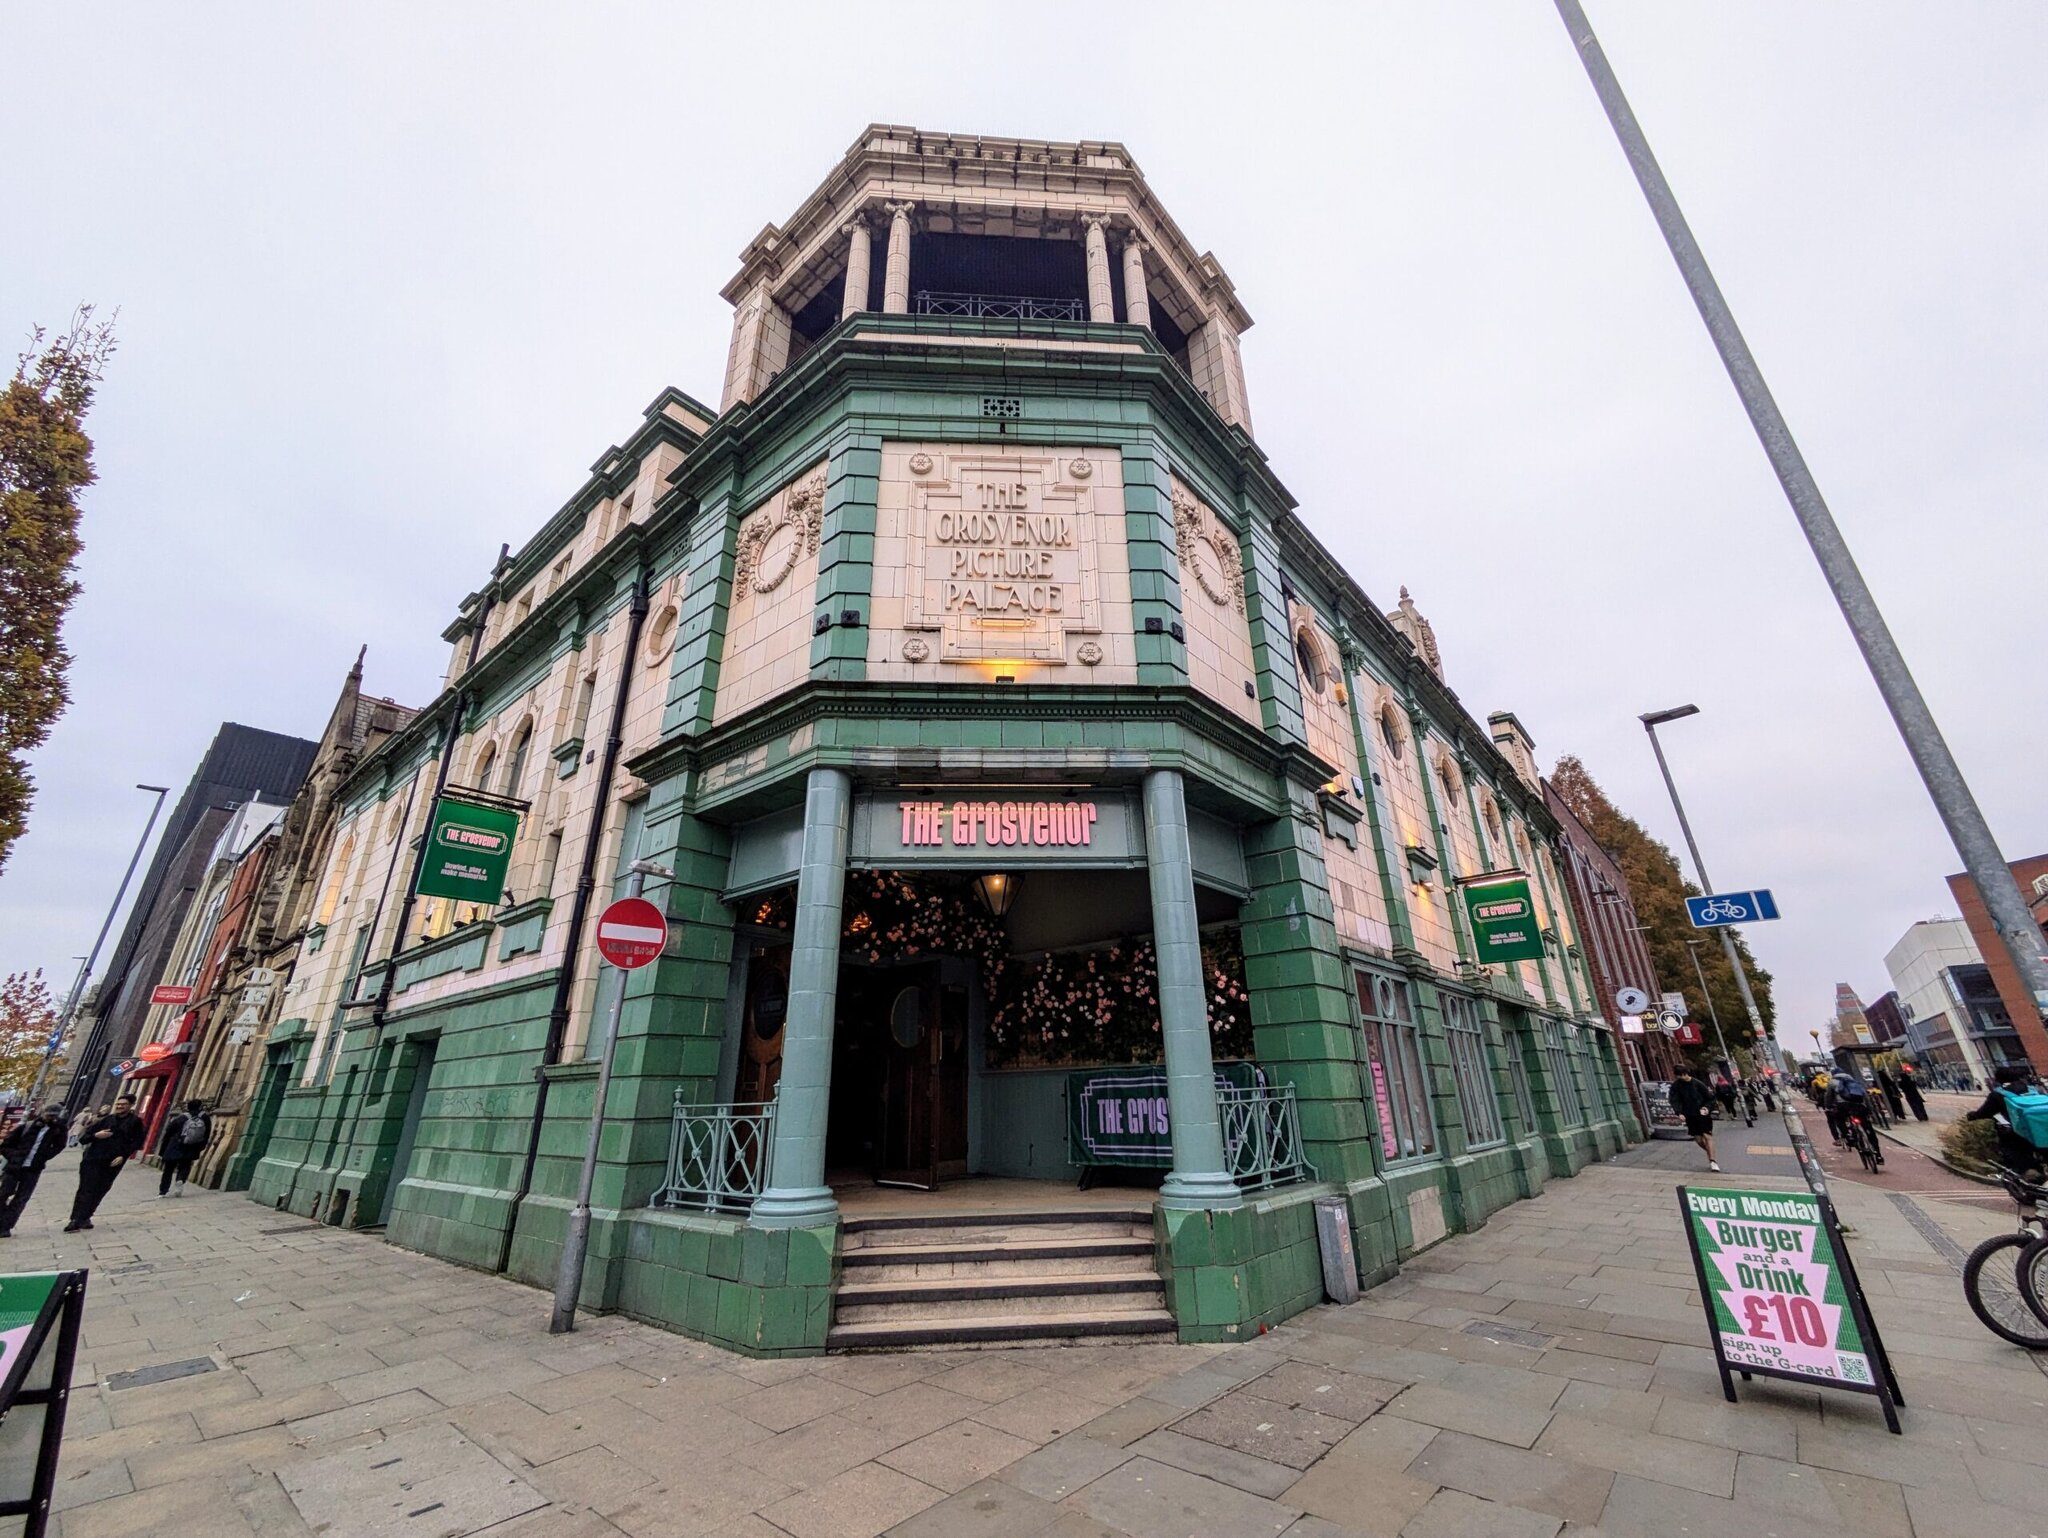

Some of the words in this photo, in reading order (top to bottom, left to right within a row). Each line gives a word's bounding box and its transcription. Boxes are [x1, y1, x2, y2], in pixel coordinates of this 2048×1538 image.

[977, 483, 1027, 509] THE
[936, 513, 1072, 546] GROSVENOR
[951, 549, 1053, 579] PICTURE
[945, 583, 1062, 613] PALACE
[446, 828, 460, 841] THE
[900, 802, 943, 846] THE
[1478, 907, 1490, 917] THE
[1097, 1099, 1124, 1134] THE
[1127, 1097, 1170, 1135] Gros
[1687, 1193, 1737, 1217] Every
[1741, 1196, 1821, 1223] Monday
[1716, 1220, 1803, 1253] Burger
[1743, 1252, 1775, 1265] and
[1781, 1257, 1791, 1265] a
[1735, 1263, 1810, 1296] Drink
[1743, 1294, 1828, 1348] £10
[1722, 1337, 1755, 1352] sign
[1759, 1345, 1782, 1356] up
[1726, 1350, 1741, 1361] to
[1747, 1353, 1774, 1366] the
[1778, 1358, 1836, 1378] G-card
